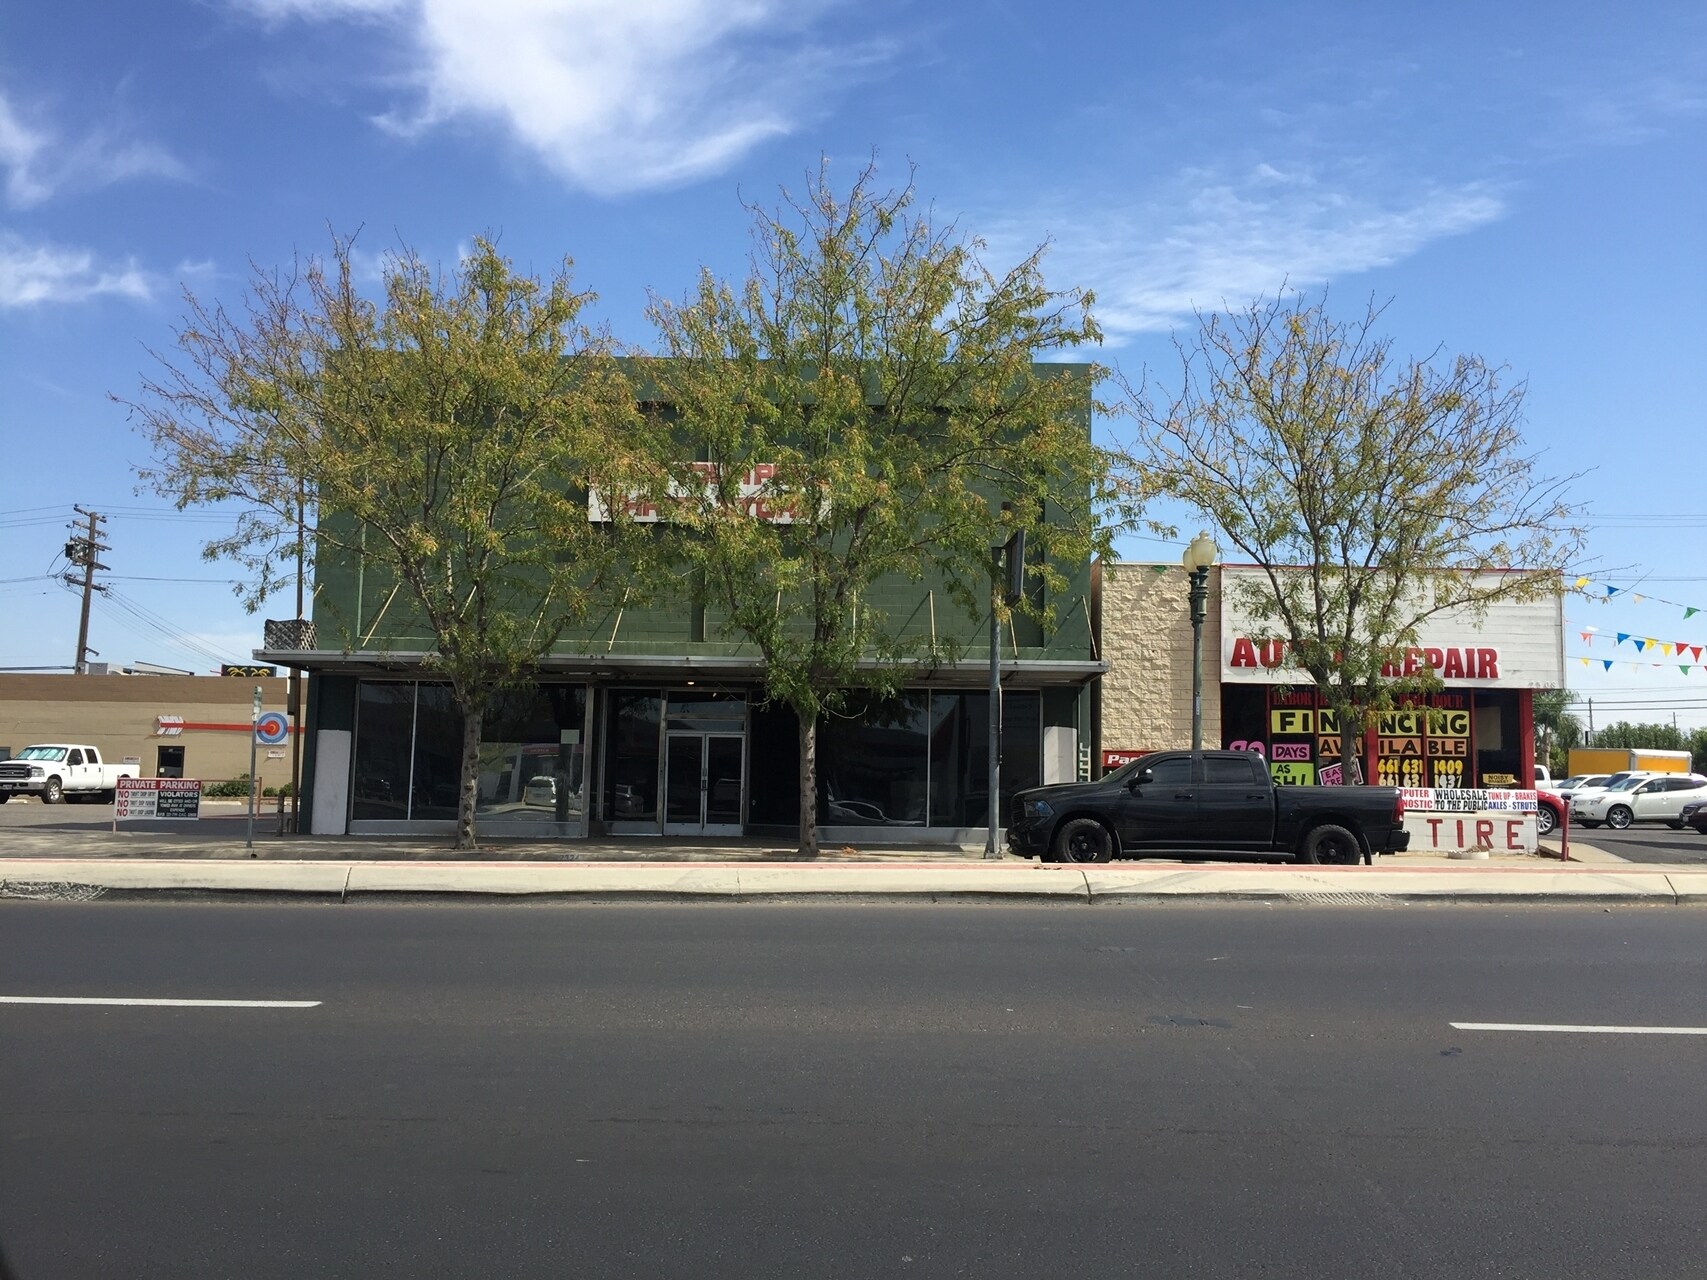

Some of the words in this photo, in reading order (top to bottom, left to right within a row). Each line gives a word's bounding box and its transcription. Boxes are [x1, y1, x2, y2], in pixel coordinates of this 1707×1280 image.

[1230, 638, 1345, 669] AU
[1280, 711, 1468, 735] FINNCING
[1275, 746, 1307, 758] DAYS
[1320, 739, 1465, 755] AVILABLE
[1276, 764, 1291, 774] AS
[1378, 759, 1399, 774] 661
[1402, 759, 1424, 774] 631
[120, 780, 156, 789] PRIVATE
[160, 781, 199, 790] PARKING
[1378, 774, 1399, 788] 661
[1403, 774, 1425, 788] 631
[1435, 790, 1488, 800] WHOLESALE
[1488, 792, 1503, 800] TUNE
[1503, 792, 1512, 800] UP
[1515, 792, 1537, 800] BRAKES
[117, 800, 128, 808] NO
[1435, 800, 1446, 809] TO
[1447, 800, 1462, 809] THE
[1463, 801, 1488, 810] PUBLIC
[1488, 801, 1507, 809] AXLES
[1512, 801, 1537, 810] STRUTS
[116, 809, 128, 817] NO
[1426, 818, 1525, 850] TIRE
